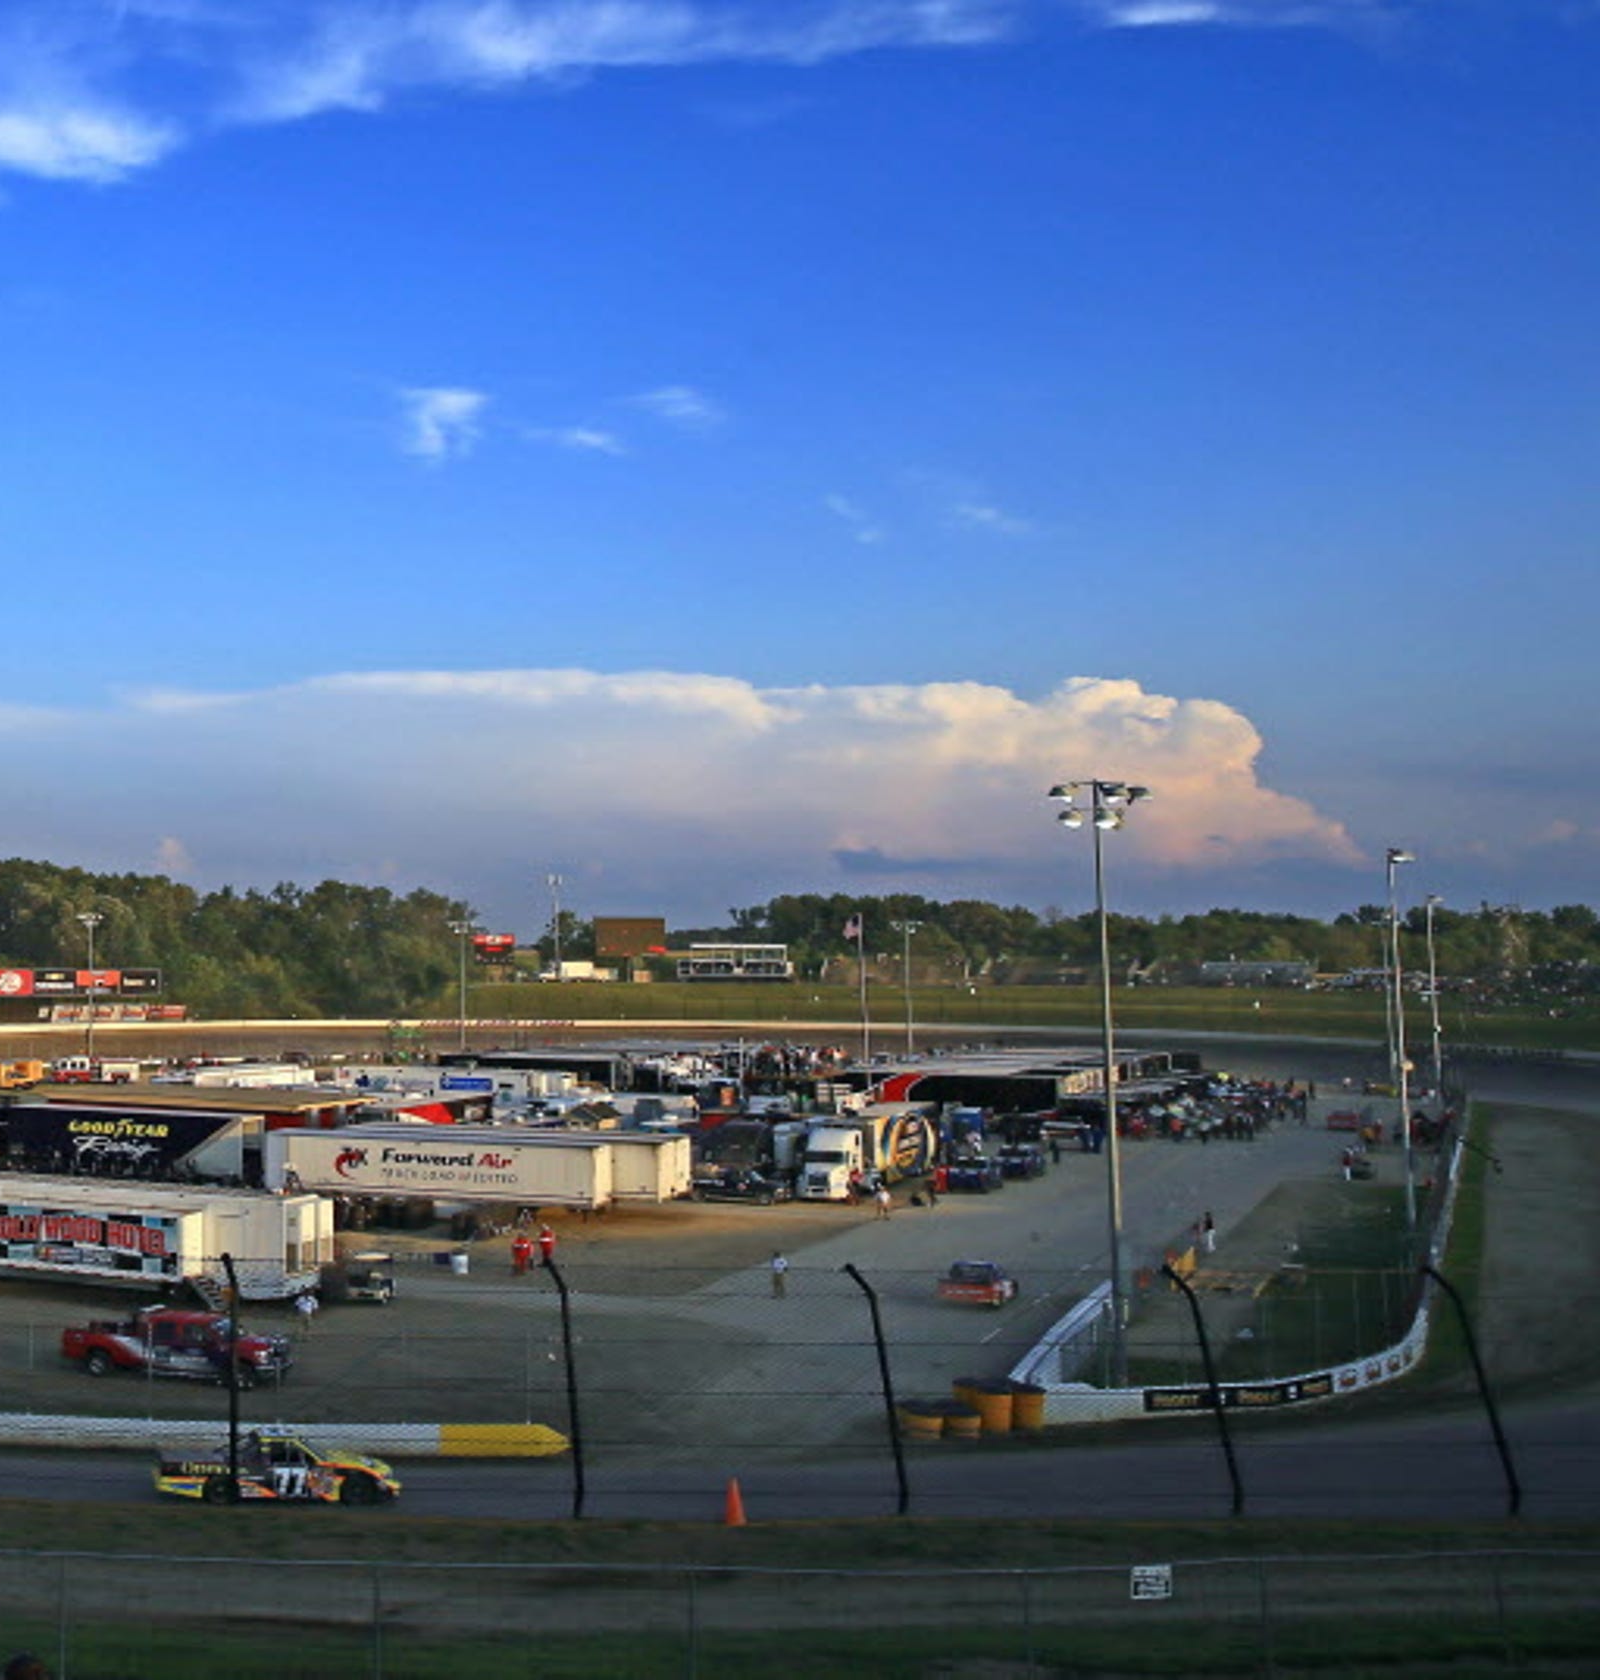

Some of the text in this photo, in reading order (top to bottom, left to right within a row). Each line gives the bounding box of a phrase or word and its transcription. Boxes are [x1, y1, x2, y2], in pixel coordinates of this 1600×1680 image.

[67, 1118, 169, 1138] GOODYEAR
[382, 1147, 513, 1169] Forward Air
[106, 1220, 168, 1257] HOTEL
[274, 1465, 308, 1497] 77
